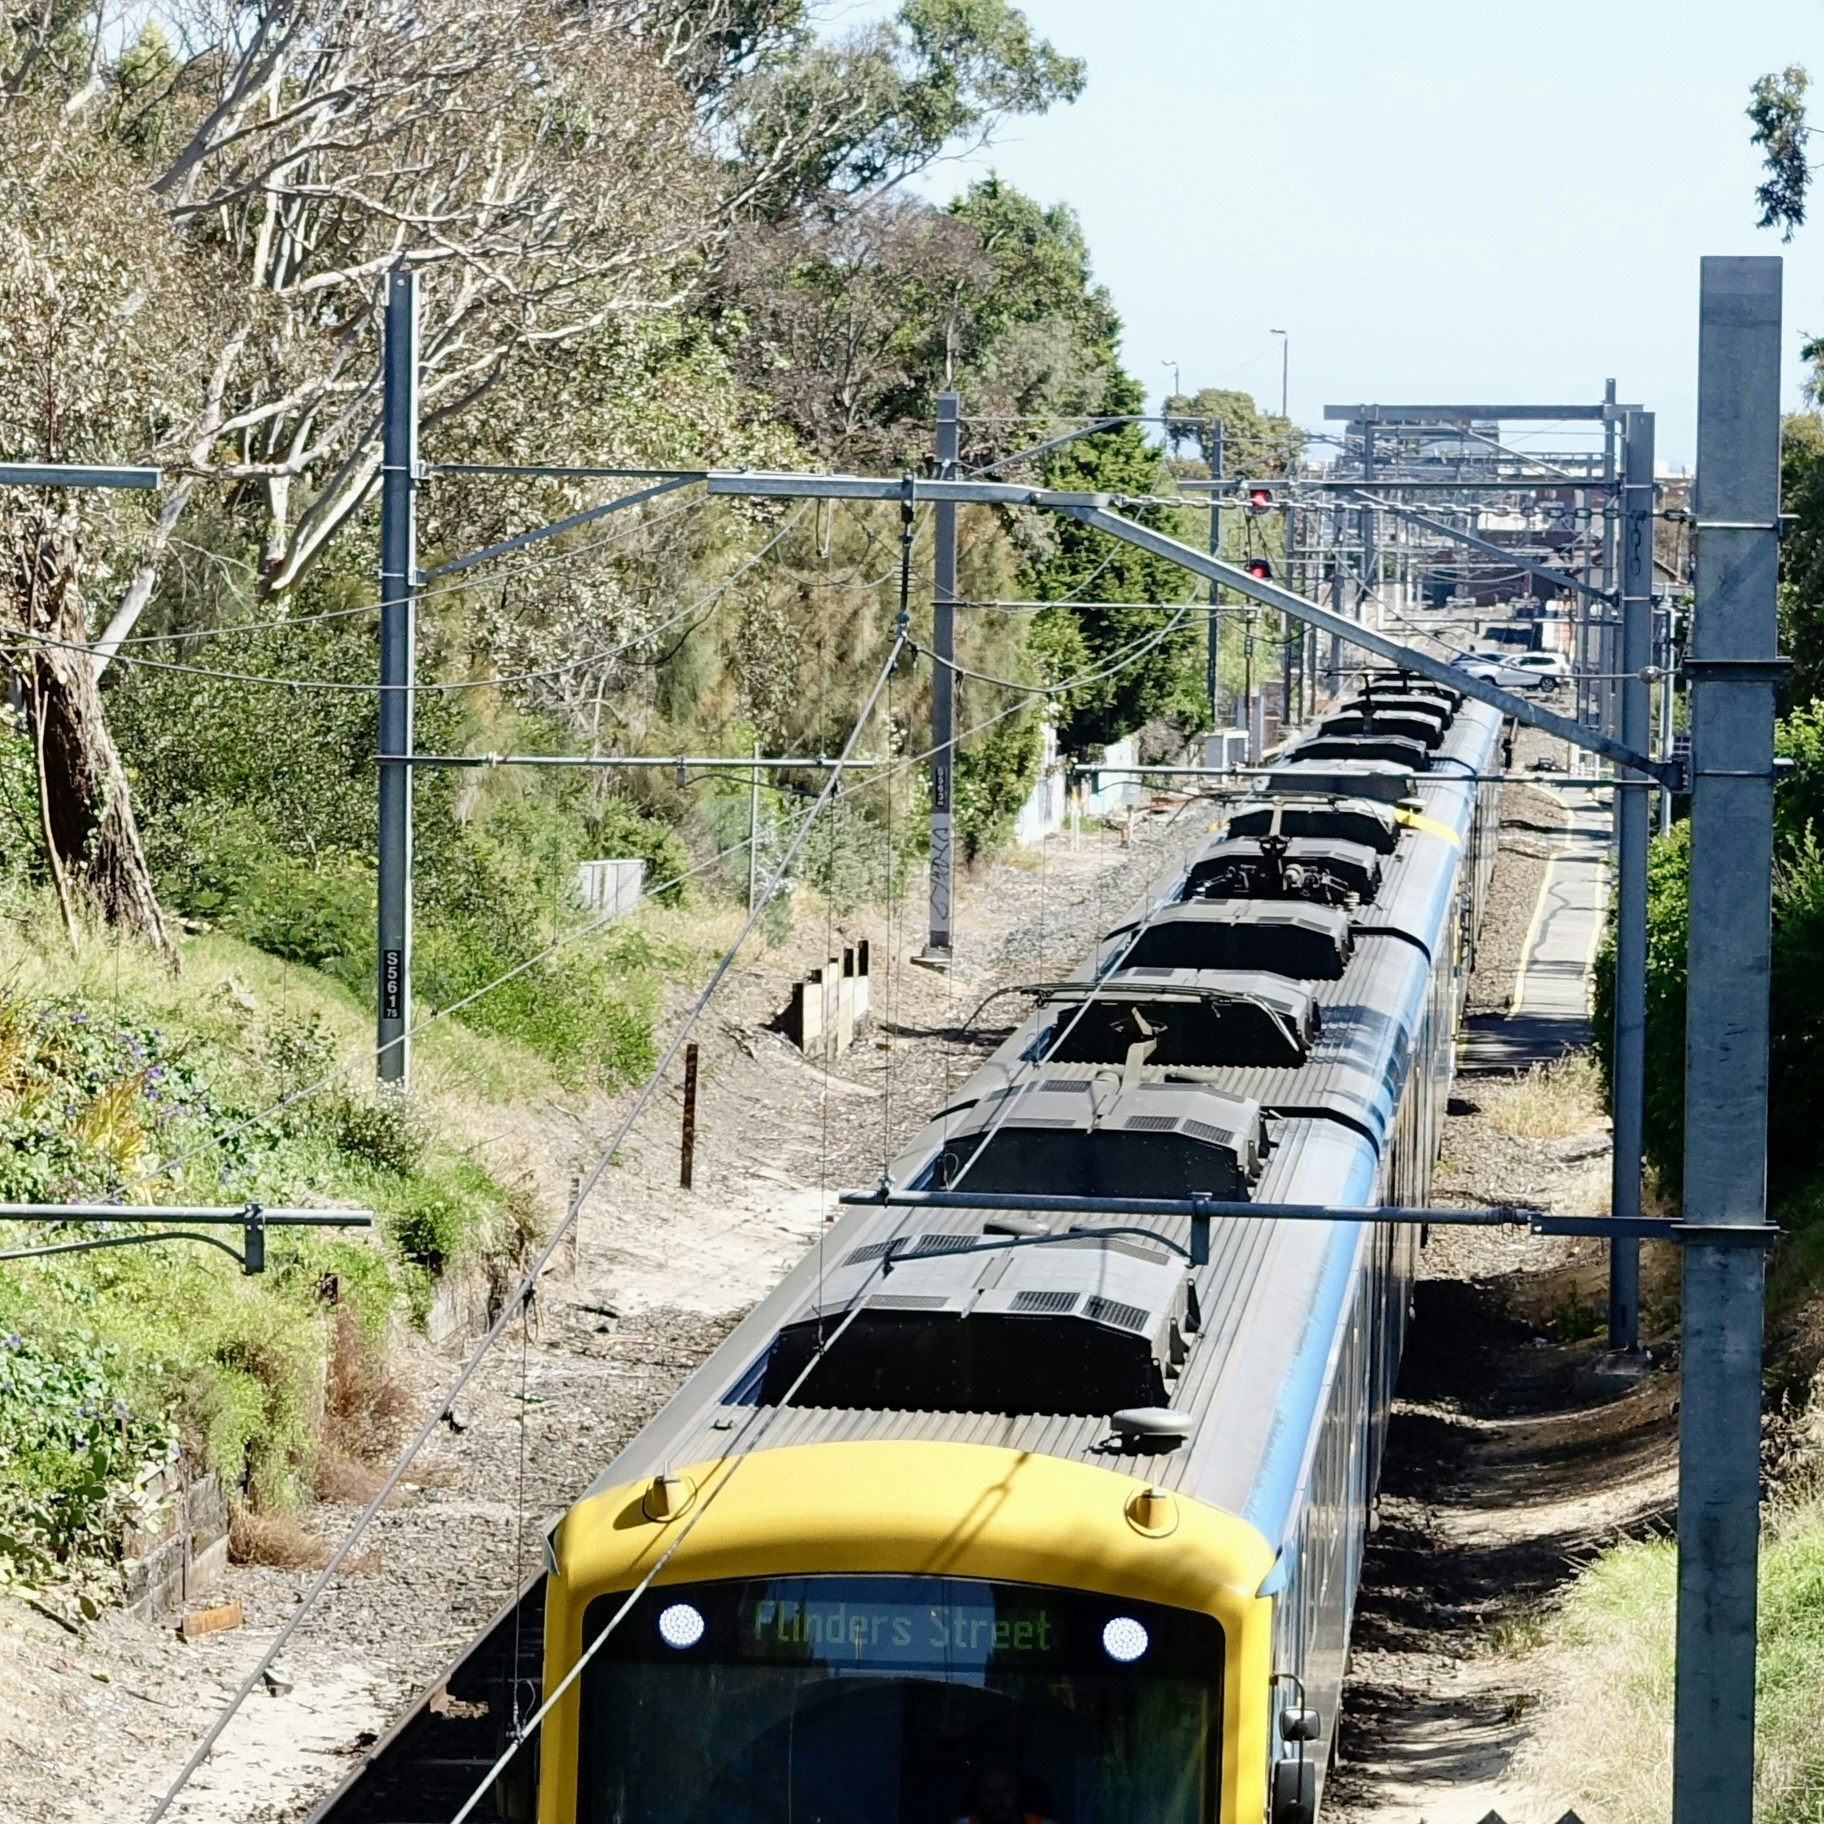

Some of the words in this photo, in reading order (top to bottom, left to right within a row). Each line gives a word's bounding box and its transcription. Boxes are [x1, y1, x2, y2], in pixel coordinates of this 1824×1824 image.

[387, 952, 398, 1007] S561
[386, 1008, 397, 1017] 75
[755, 1600, 911, 1646] Flinders
[930, 1606, 1051, 1650] Street
